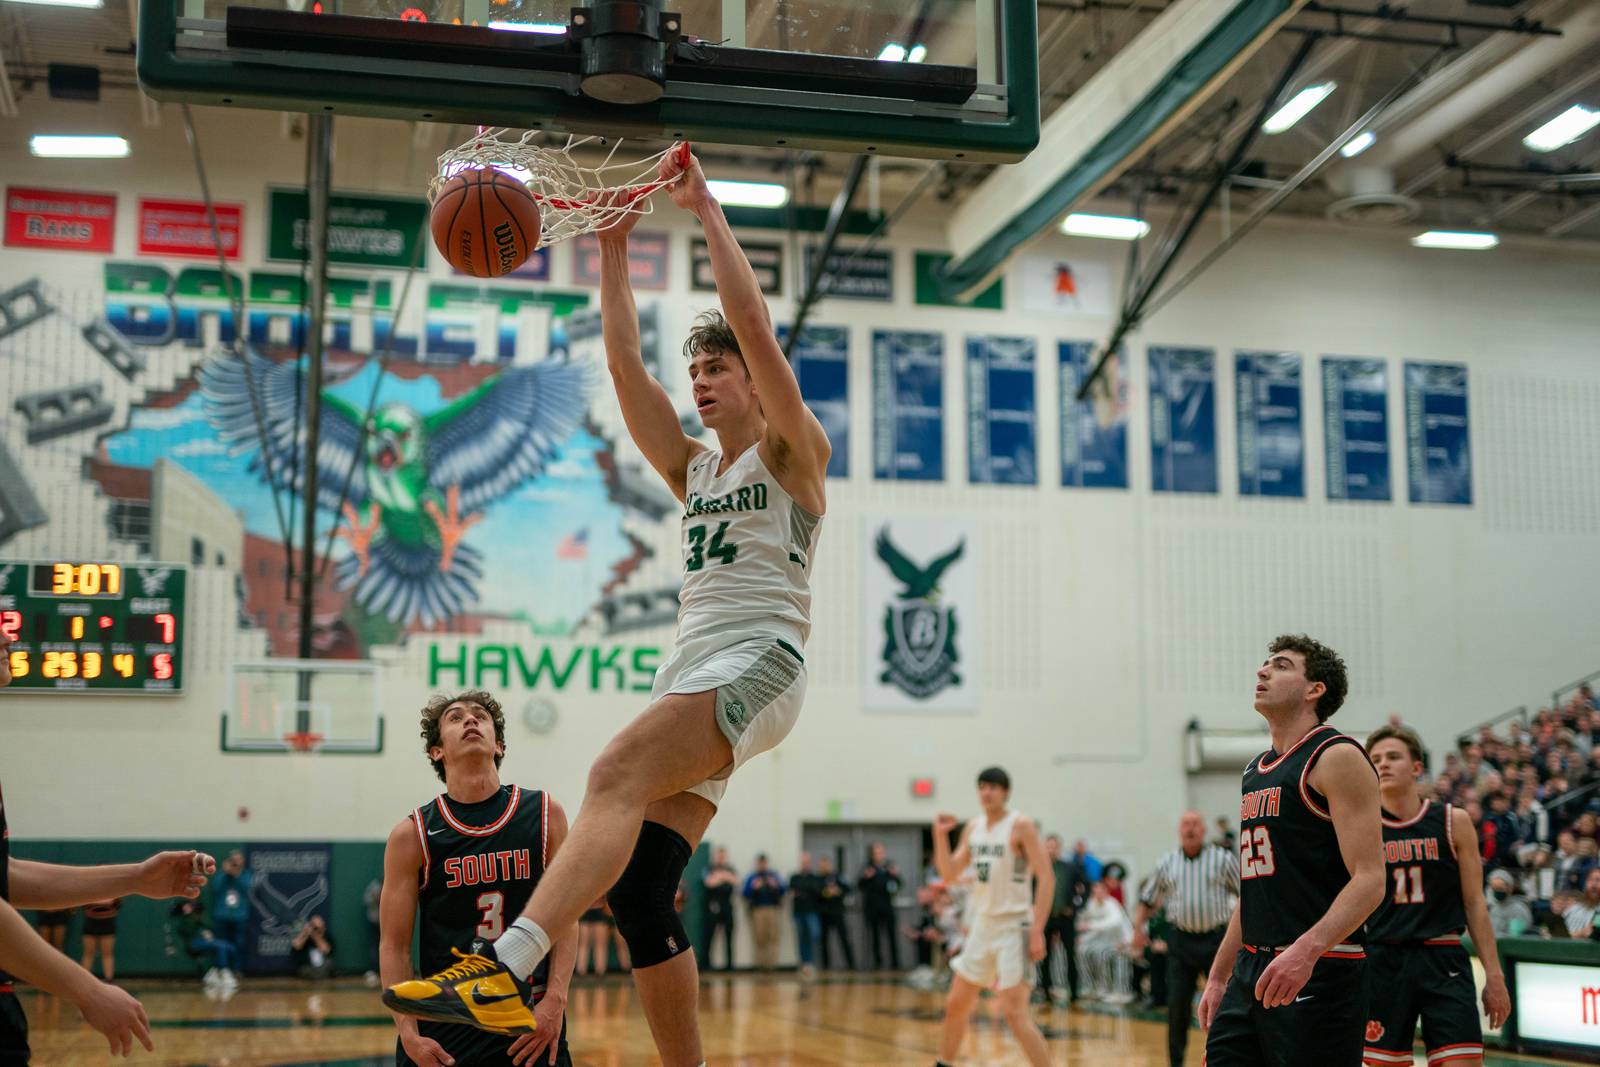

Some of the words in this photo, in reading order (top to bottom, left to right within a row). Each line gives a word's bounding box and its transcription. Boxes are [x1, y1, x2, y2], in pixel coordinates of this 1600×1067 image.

[25, 214, 93, 243] RAMS
[494, 221, 518, 273] Wilso
[686, 520, 738, 573] 34
[53, 563, 121, 596] 3:07
[0, 611, 22, 641] 2
[71, 616, 84, 640] 1
[154, 613, 176, 644] 7
[42, 651, 78, 679] 25
[82, 652, 102, 679] 3
[113, 653, 135, 679] 4
[153, 653, 173, 680] 5
[427, 642, 663, 692] HAWKS
[444, 848, 531, 889] SOUTH
[1240, 825, 1276, 881] 23
[1391, 865, 1425, 905] 11
[476, 890, 506, 941] 3
